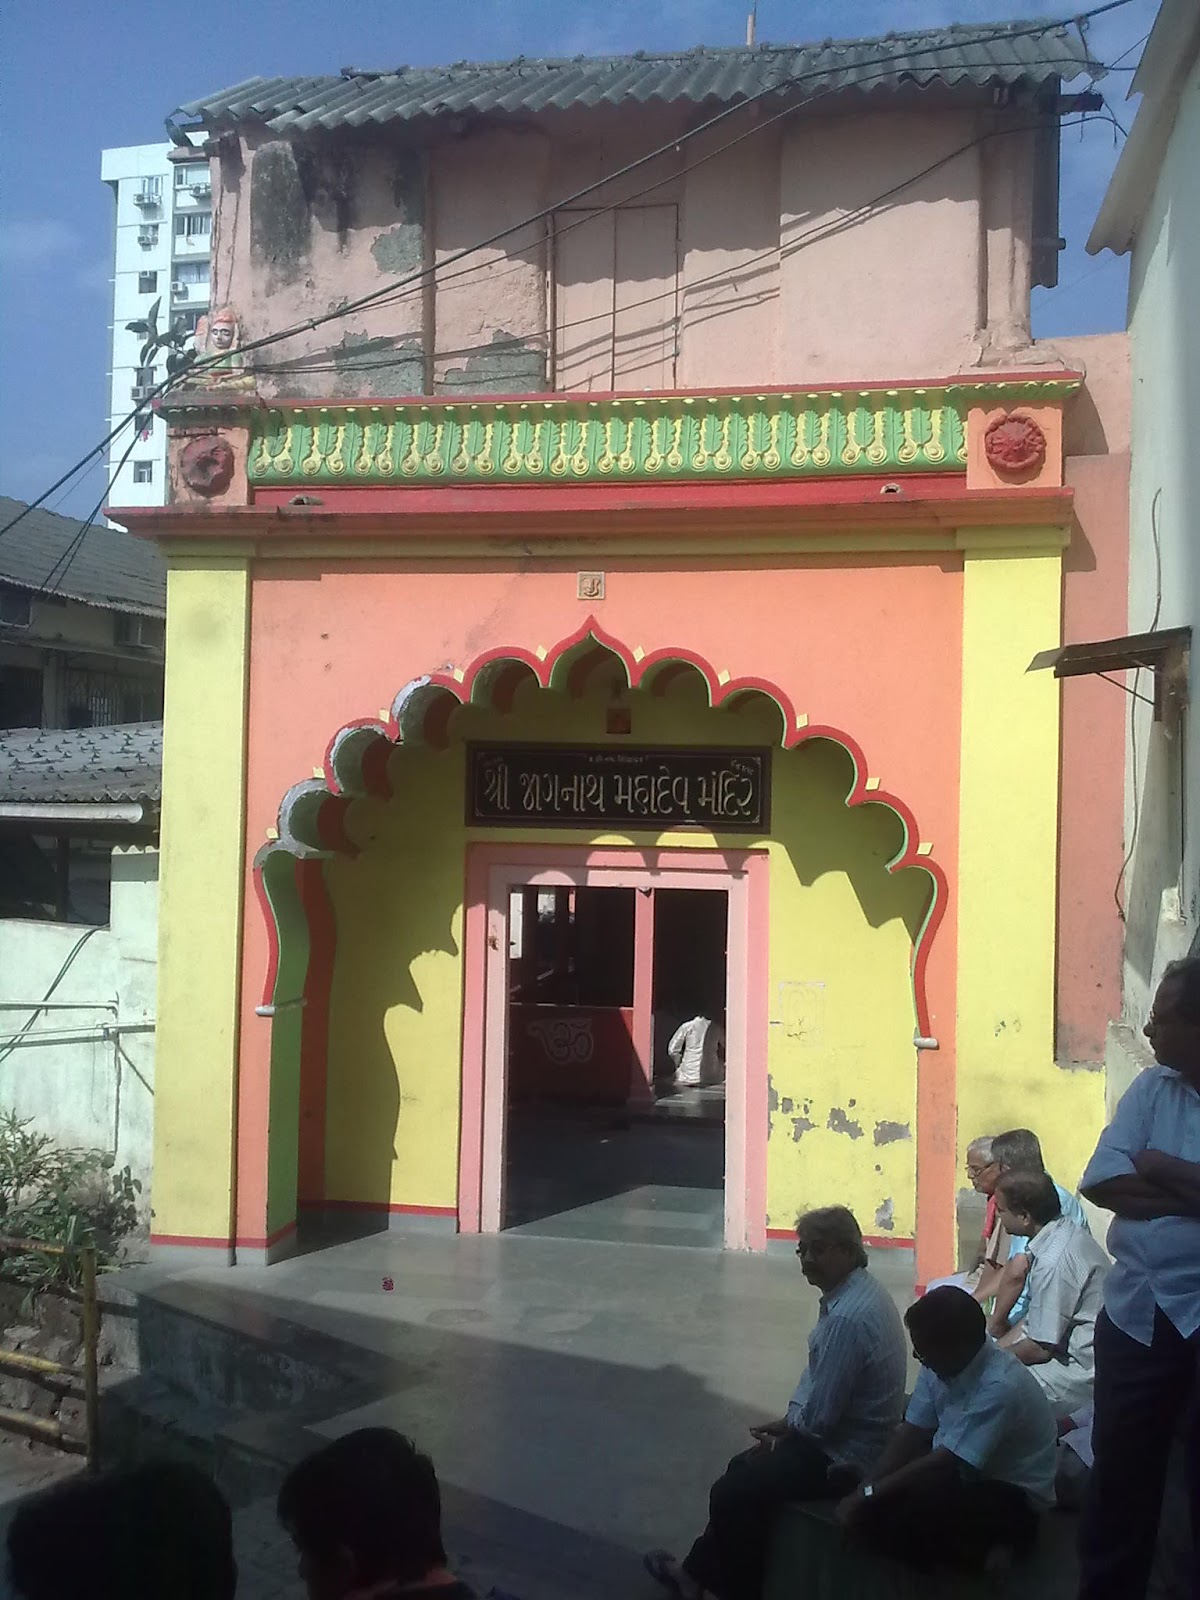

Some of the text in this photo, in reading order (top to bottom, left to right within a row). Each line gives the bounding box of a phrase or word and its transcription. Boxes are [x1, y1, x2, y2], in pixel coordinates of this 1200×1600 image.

[483, 763, 510, 811] શ્રી
[613, 765, 691, 816] મહાદેવ
[697, 769, 754, 817] મંદિર
